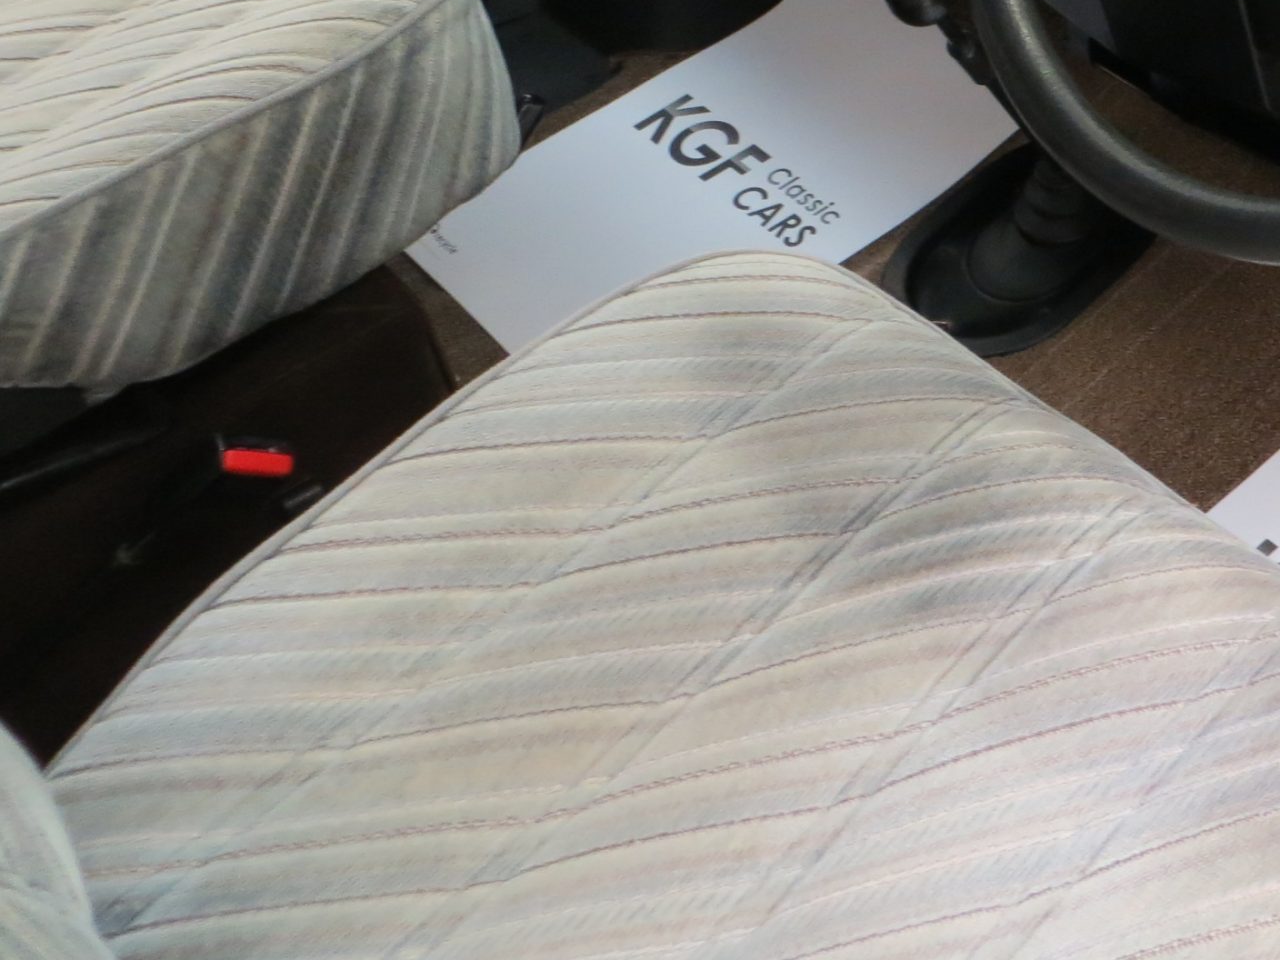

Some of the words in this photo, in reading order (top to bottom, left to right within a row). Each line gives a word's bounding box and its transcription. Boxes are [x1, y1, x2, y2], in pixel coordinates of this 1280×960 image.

[633, 93, 772, 182] KGF
[731, 185, 817, 247] CARS
[766, 166, 842, 225] Classic
